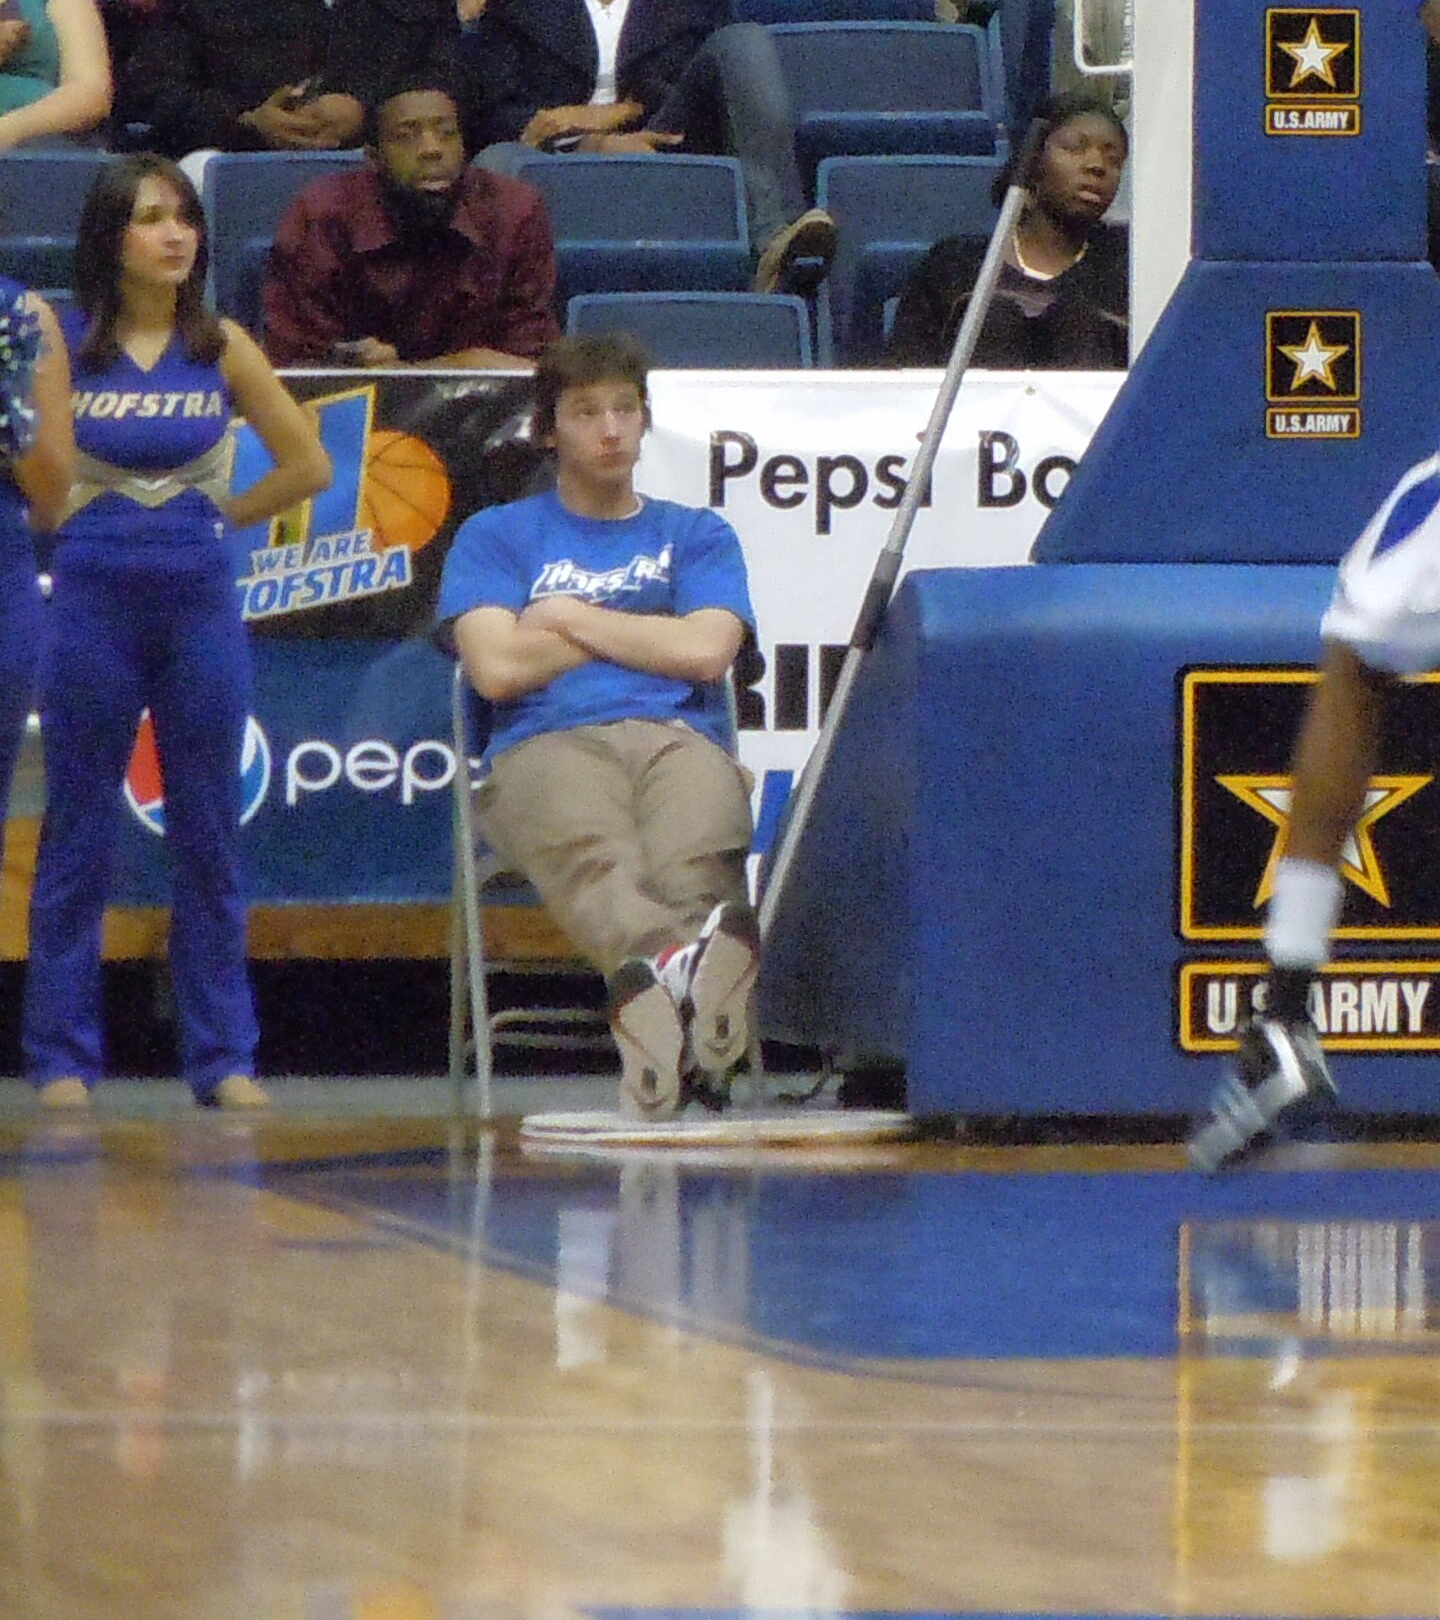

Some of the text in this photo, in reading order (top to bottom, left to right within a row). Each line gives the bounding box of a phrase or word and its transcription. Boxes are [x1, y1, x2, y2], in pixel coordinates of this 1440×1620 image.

[69, 390, 223, 419] HOFSTRA
[975, 429, 1080, 509] Bo
[246, 548, 411, 615] OFSTRA
[253, 533, 371, 574] WE ARE
[286, 739, 484, 806] pep
